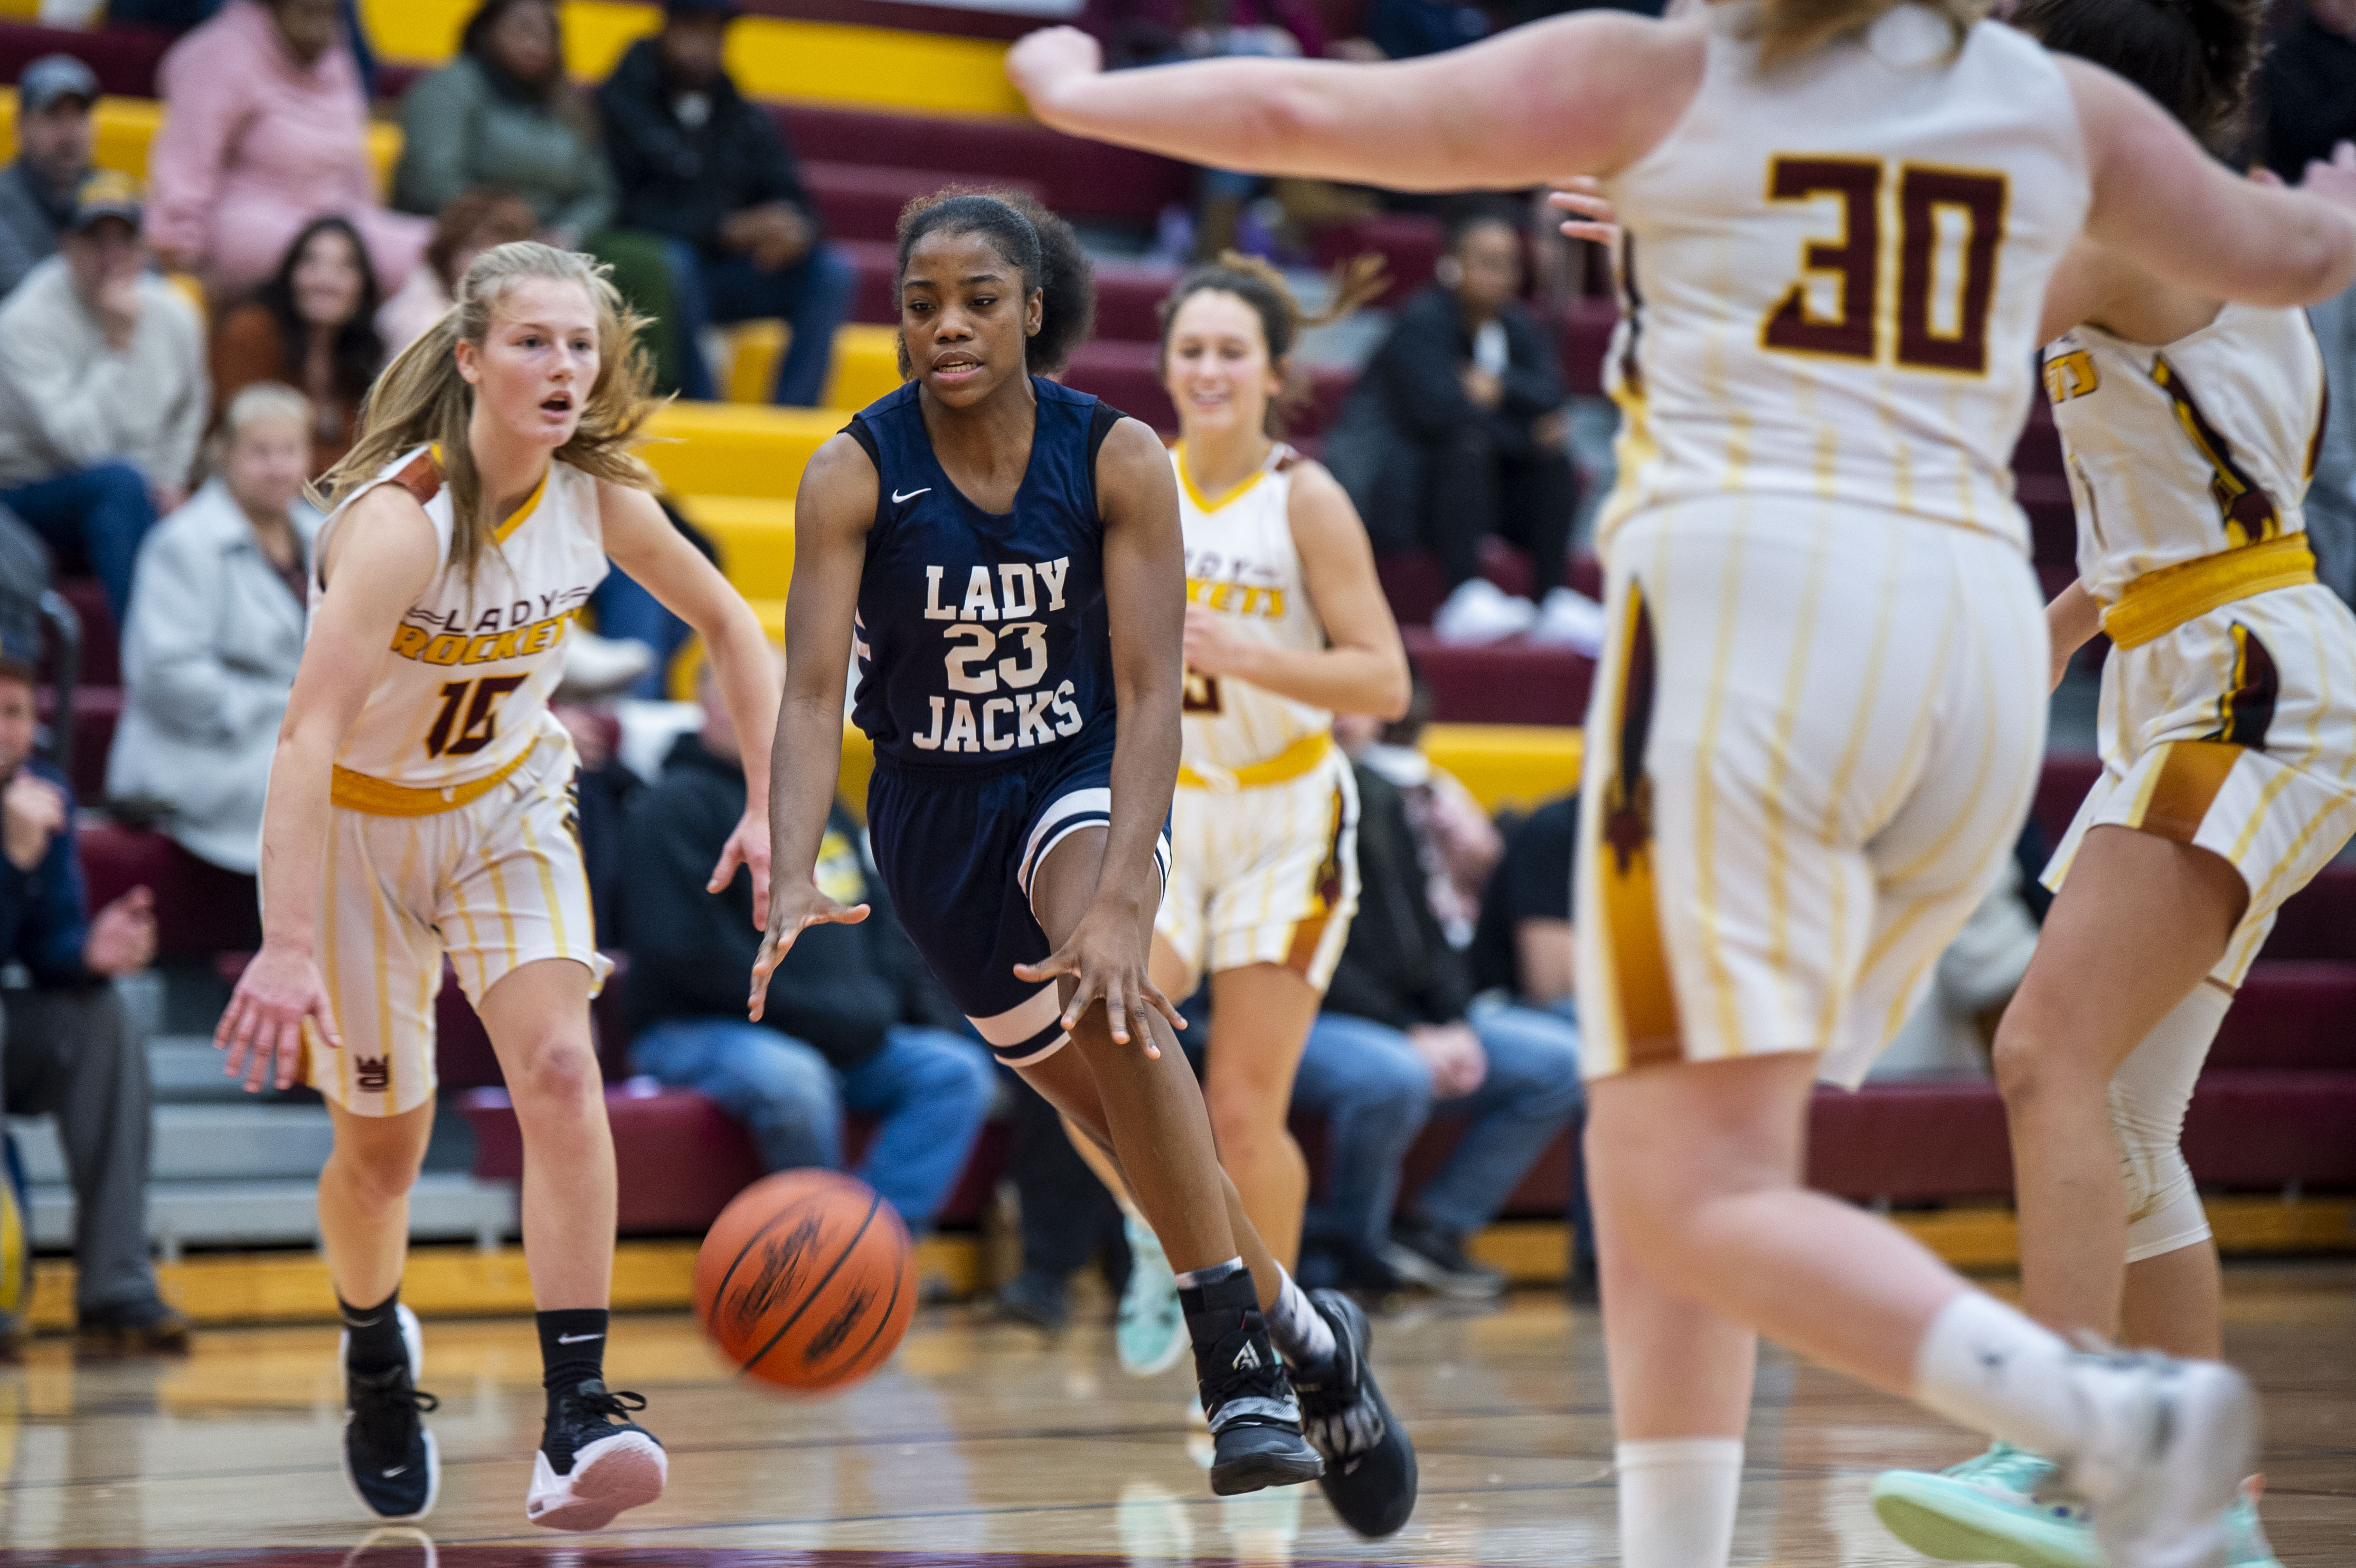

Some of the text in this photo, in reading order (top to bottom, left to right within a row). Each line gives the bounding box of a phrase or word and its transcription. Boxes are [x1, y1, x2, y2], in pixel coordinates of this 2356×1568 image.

[1756, 150, 2012, 382] 30
[444, 590, 558, 632] LADY
[925, 556, 1069, 621] LADY
[943, 621, 1048, 694] 23
[912, 679, 1083, 752] JACKS
